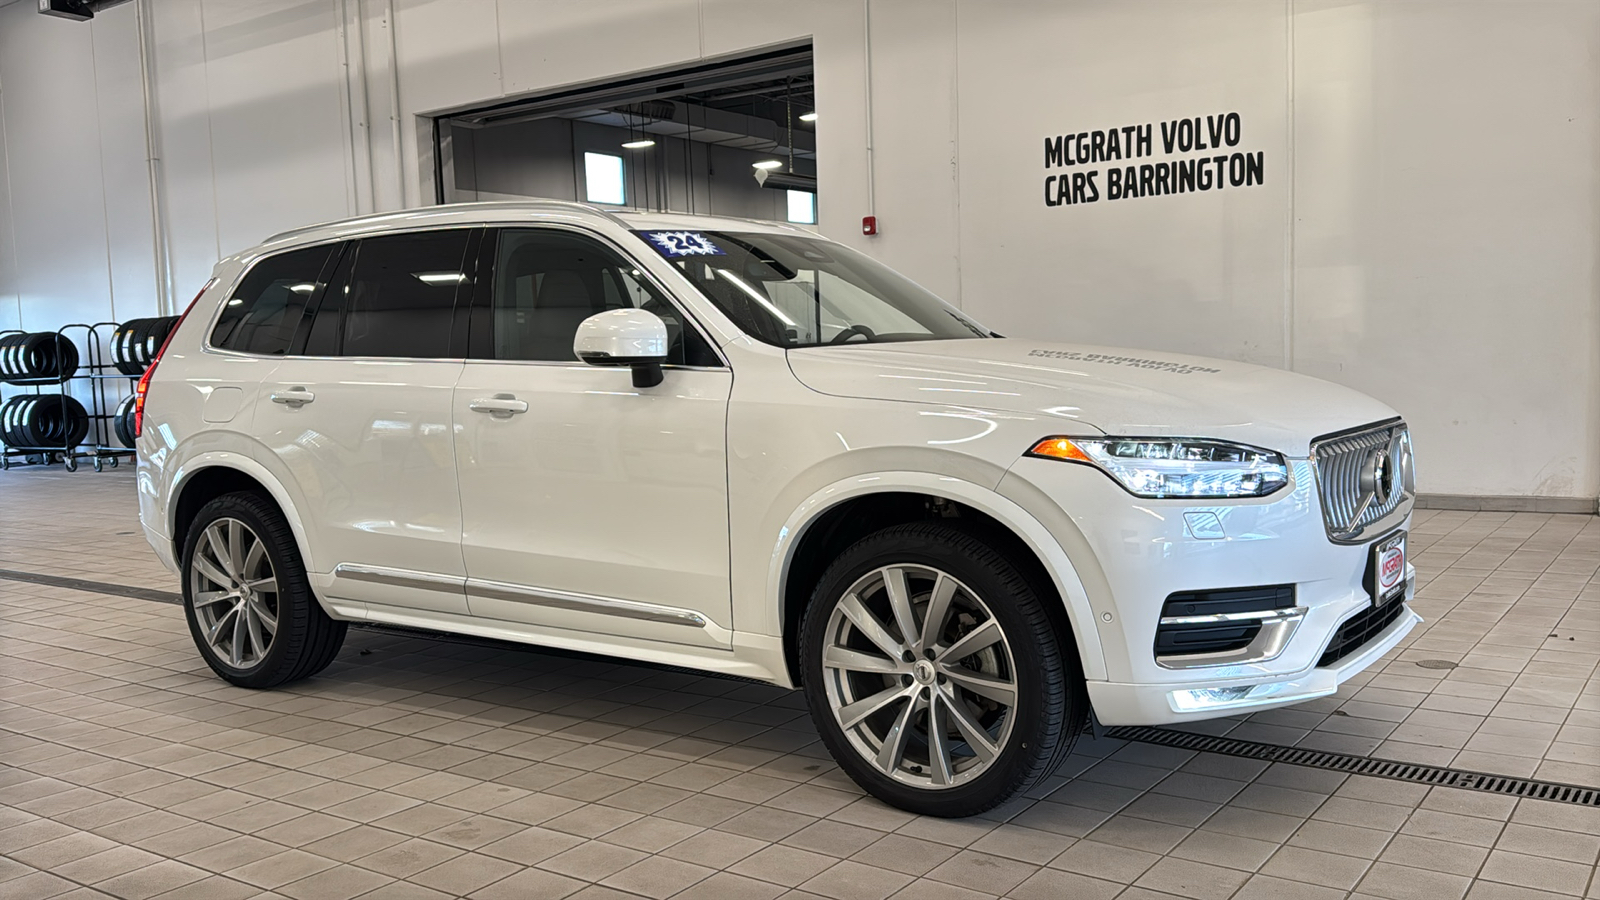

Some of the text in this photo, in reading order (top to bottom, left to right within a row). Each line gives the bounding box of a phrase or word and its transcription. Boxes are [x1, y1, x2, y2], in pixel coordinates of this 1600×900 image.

[1044, 112, 1241, 169] MCGRATH VOLVO
[1044, 151, 1264, 207] CARS BARRINGTON
[666, 235, 704, 250] 24
